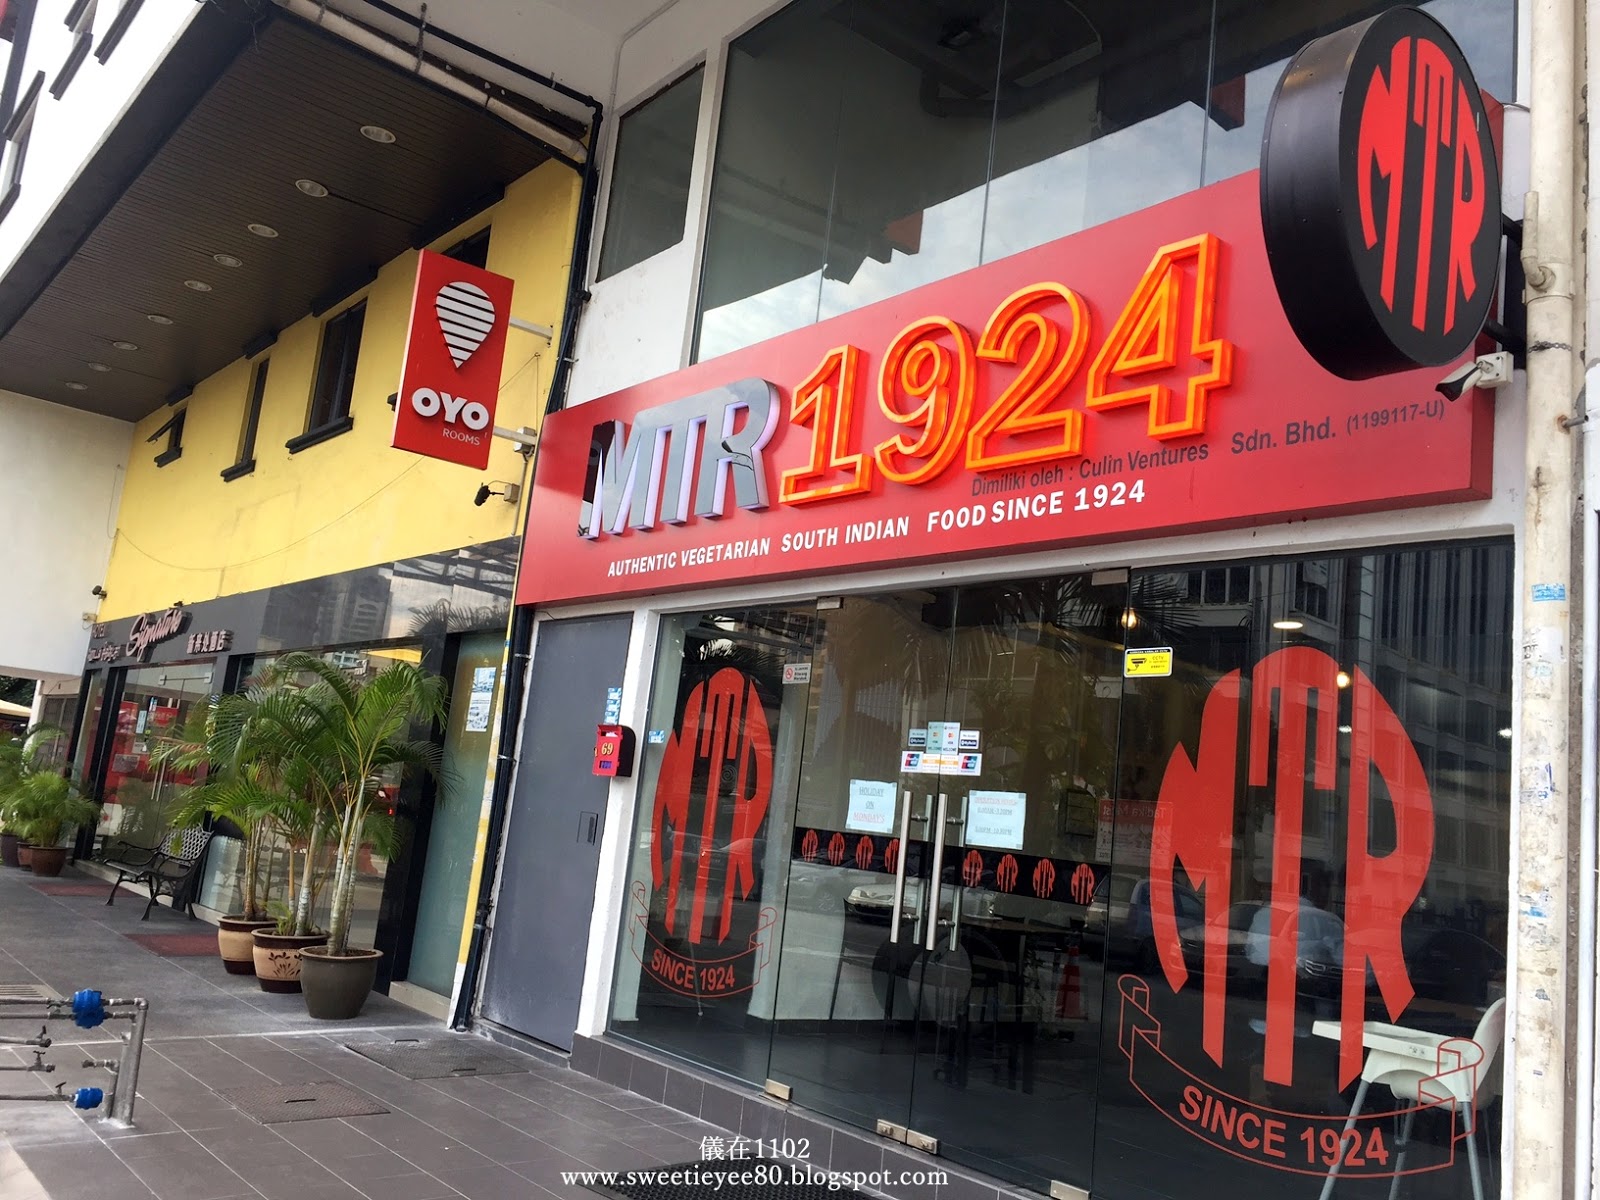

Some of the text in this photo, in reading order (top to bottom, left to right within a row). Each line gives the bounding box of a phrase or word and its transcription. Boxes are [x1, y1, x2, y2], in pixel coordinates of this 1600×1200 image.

[1357, 36, 1485, 336] MTR
[412, 387, 489, 430] OYO
[577, 232, 1234, 539] MTR 1924
[442, 428, 480, 445] ROOMS
[971, 471, 1026, 497] Dimiliki
[1030, 467, 1063, 487] oleh
[1079, 456, 1123, 479] Culin
[1127, 443, 1209, 471] Ventures
[1231, 429, 1277, 455] Sdn.
[1285, 416, 1336, 446] Bhd.
[1346, 400, 1445, 436] (1199117-U)
[607, 479, 1145, 578] AUTHENTIC VEGETARIAN SOUTH INDIAN FOOD SINCE 1924
[126, 610, 183, 661] Signature
[601, 742, 614, 755] 69
[651, 666, 773, 946] MTR
[1149, 645, 1435, 1094] MTR
[651, 949, 735, 991] SINCE 1924
[1179, 1085, 1388, 1167] SINCE 1924
